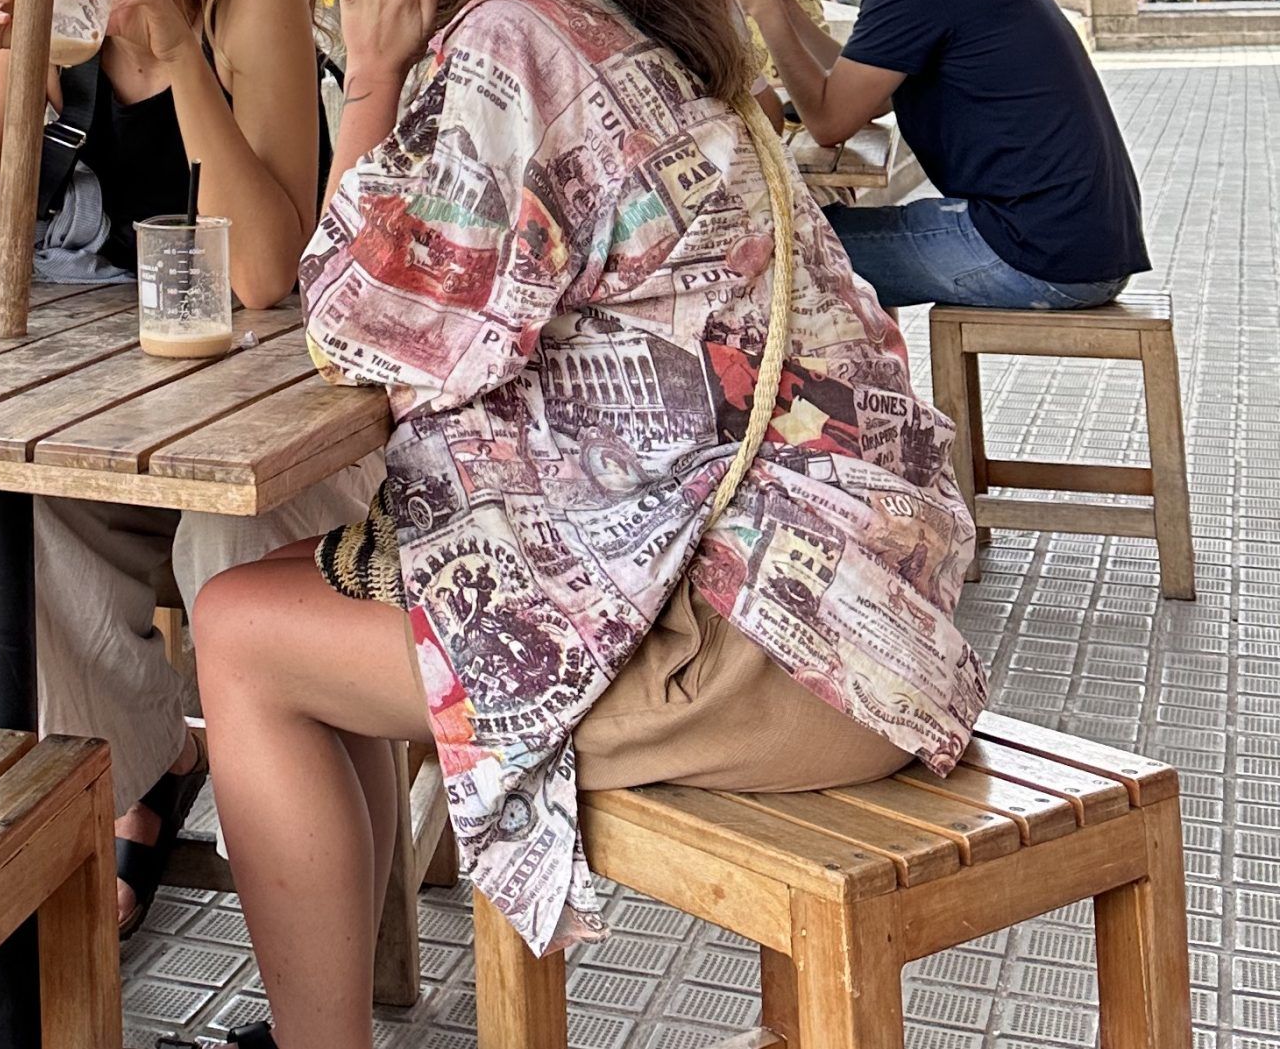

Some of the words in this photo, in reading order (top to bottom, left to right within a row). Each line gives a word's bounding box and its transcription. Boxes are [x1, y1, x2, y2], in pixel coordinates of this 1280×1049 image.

[473, 84, 510, 111] GOODS
[322, 333, 348, 351] LORD
[857, 391, 908, 417] JONES
